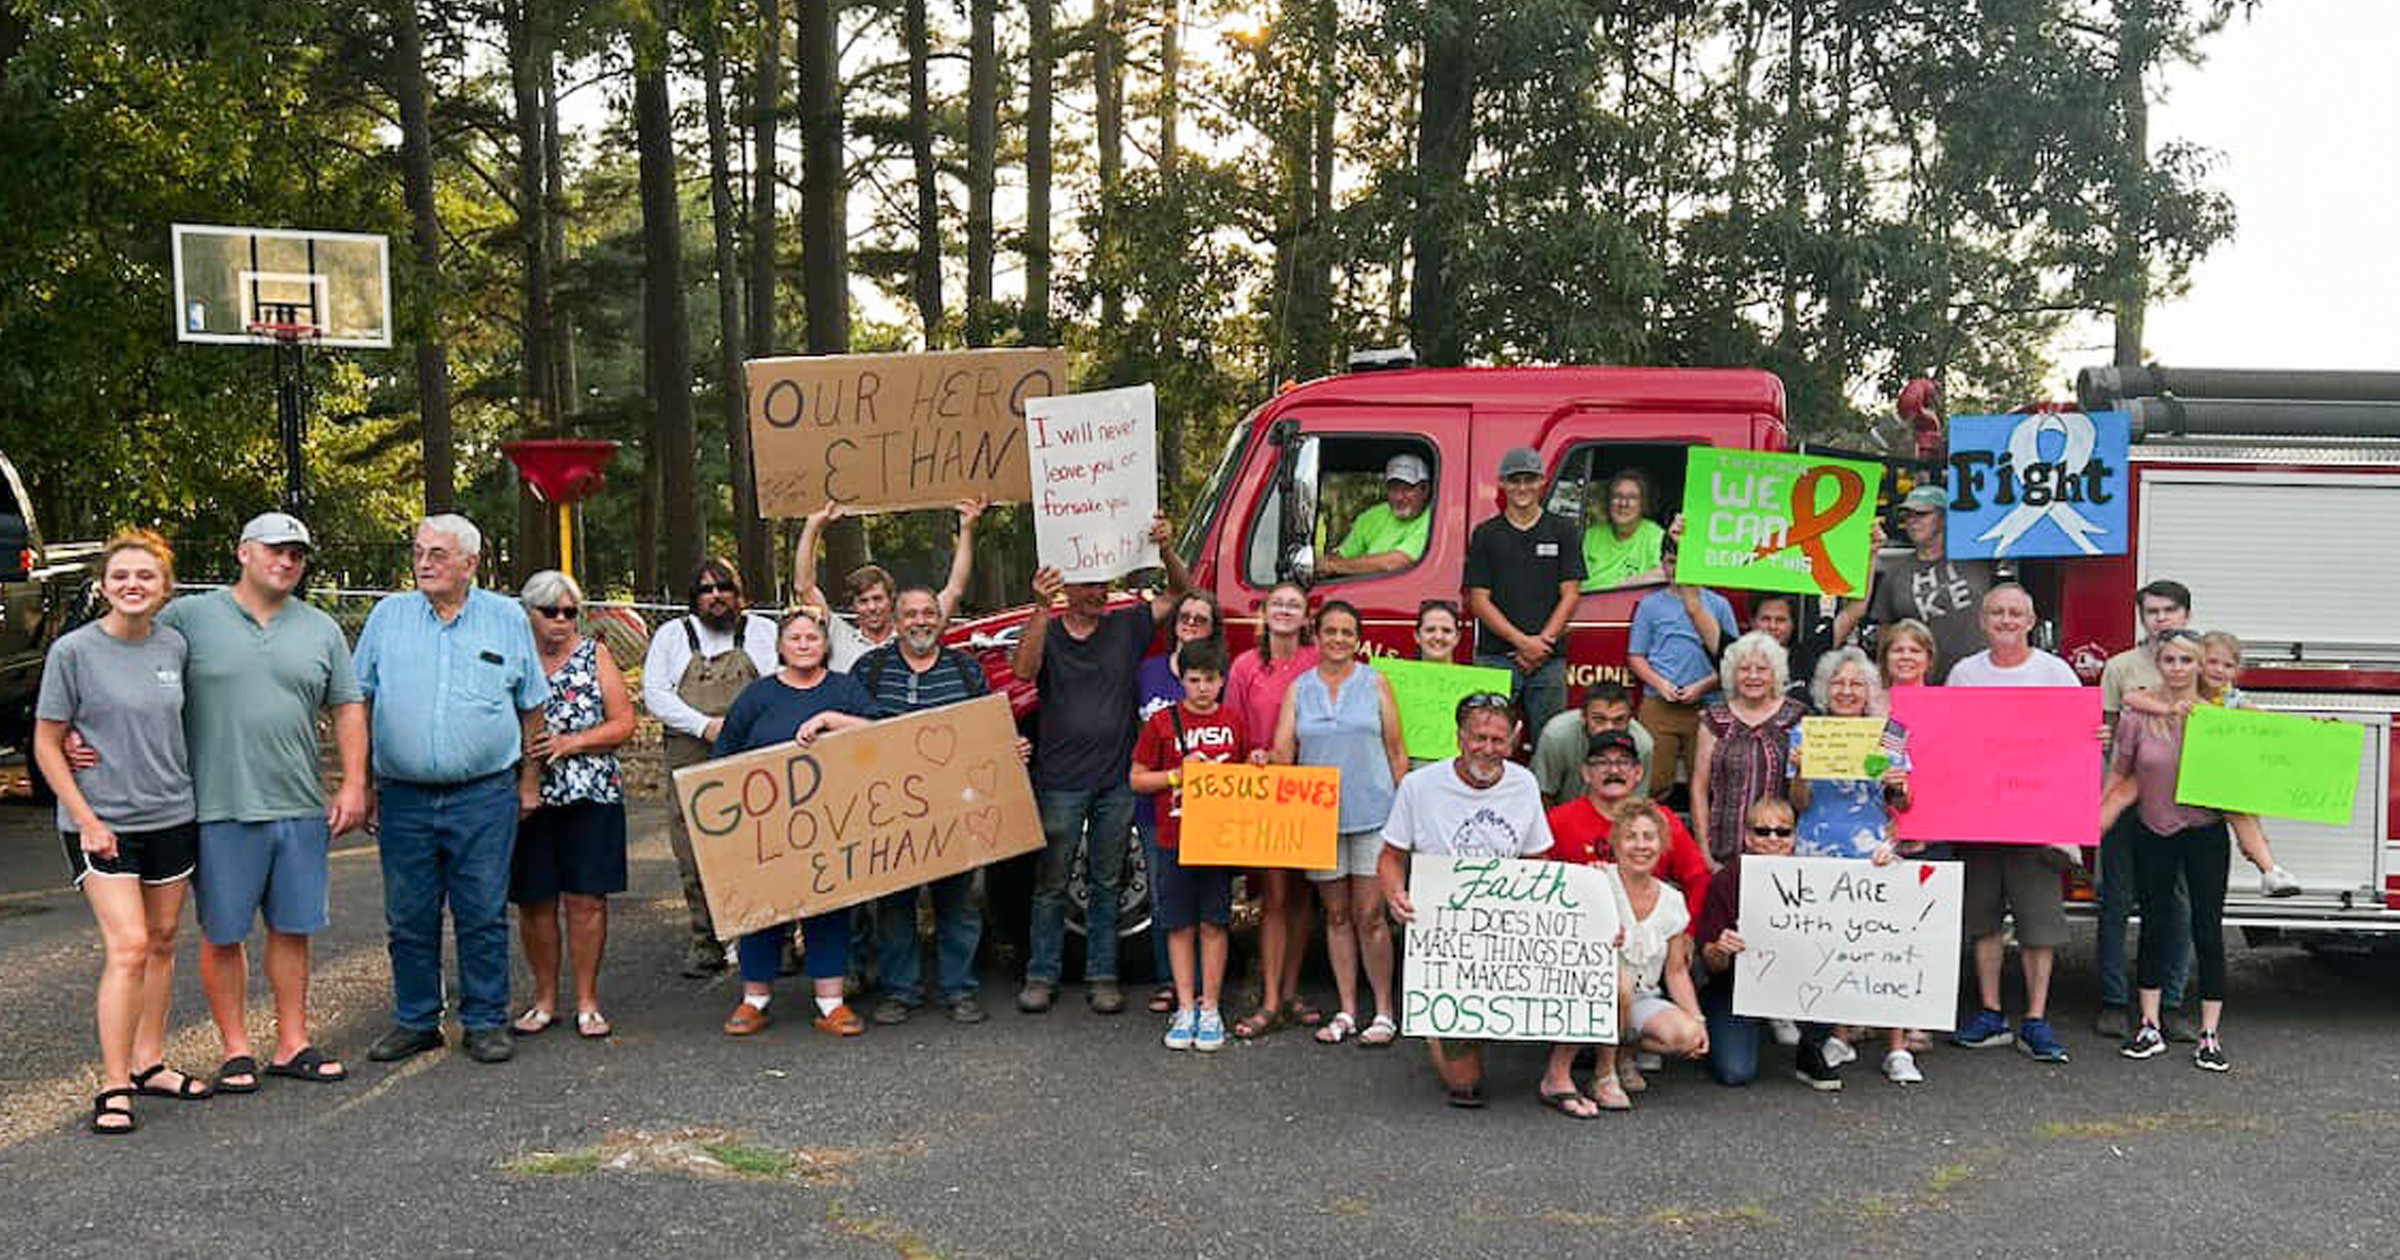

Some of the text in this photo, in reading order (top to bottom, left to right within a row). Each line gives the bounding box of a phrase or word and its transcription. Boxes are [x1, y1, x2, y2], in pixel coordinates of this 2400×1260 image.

[763, 369, 1053, 428] OUR HERO
[1030, 417, 1136, 449] I will never
[824, 428, 1017, 502] ETHAN
[1043, 452, 1137, 485] leave you or
[1949, 450, 2113, 511] Fight
[1711, 470, 1784, 508] WE
[1064, 535, 1117, 571] John
[1174, 726, 1234, 751] NASA
[689, 754, 822, 836] GOD
[1188, 773, 1337, 809] JESUS LOVES
[757, 774, 929, 865] LOVES
[1216, 817, 1306, 853] ETHAN
[811, 818, 958, 894] ETHAN
[1449, 858, 1579, 909] Faith
[1829, 871, 1888, 903] ARE
[1435, 906, 1585, 938] IT DOES NOT
[1769, 914, 1832, 935] with
[1408, 929, 1614, 967] MAKE THINGS EASY
[1881, 944, 1927, 965] not
[1423, 961, 1614, 999] IT MAKES THINGS
[1405, 990, 1614, 1039] POSSIBLE
